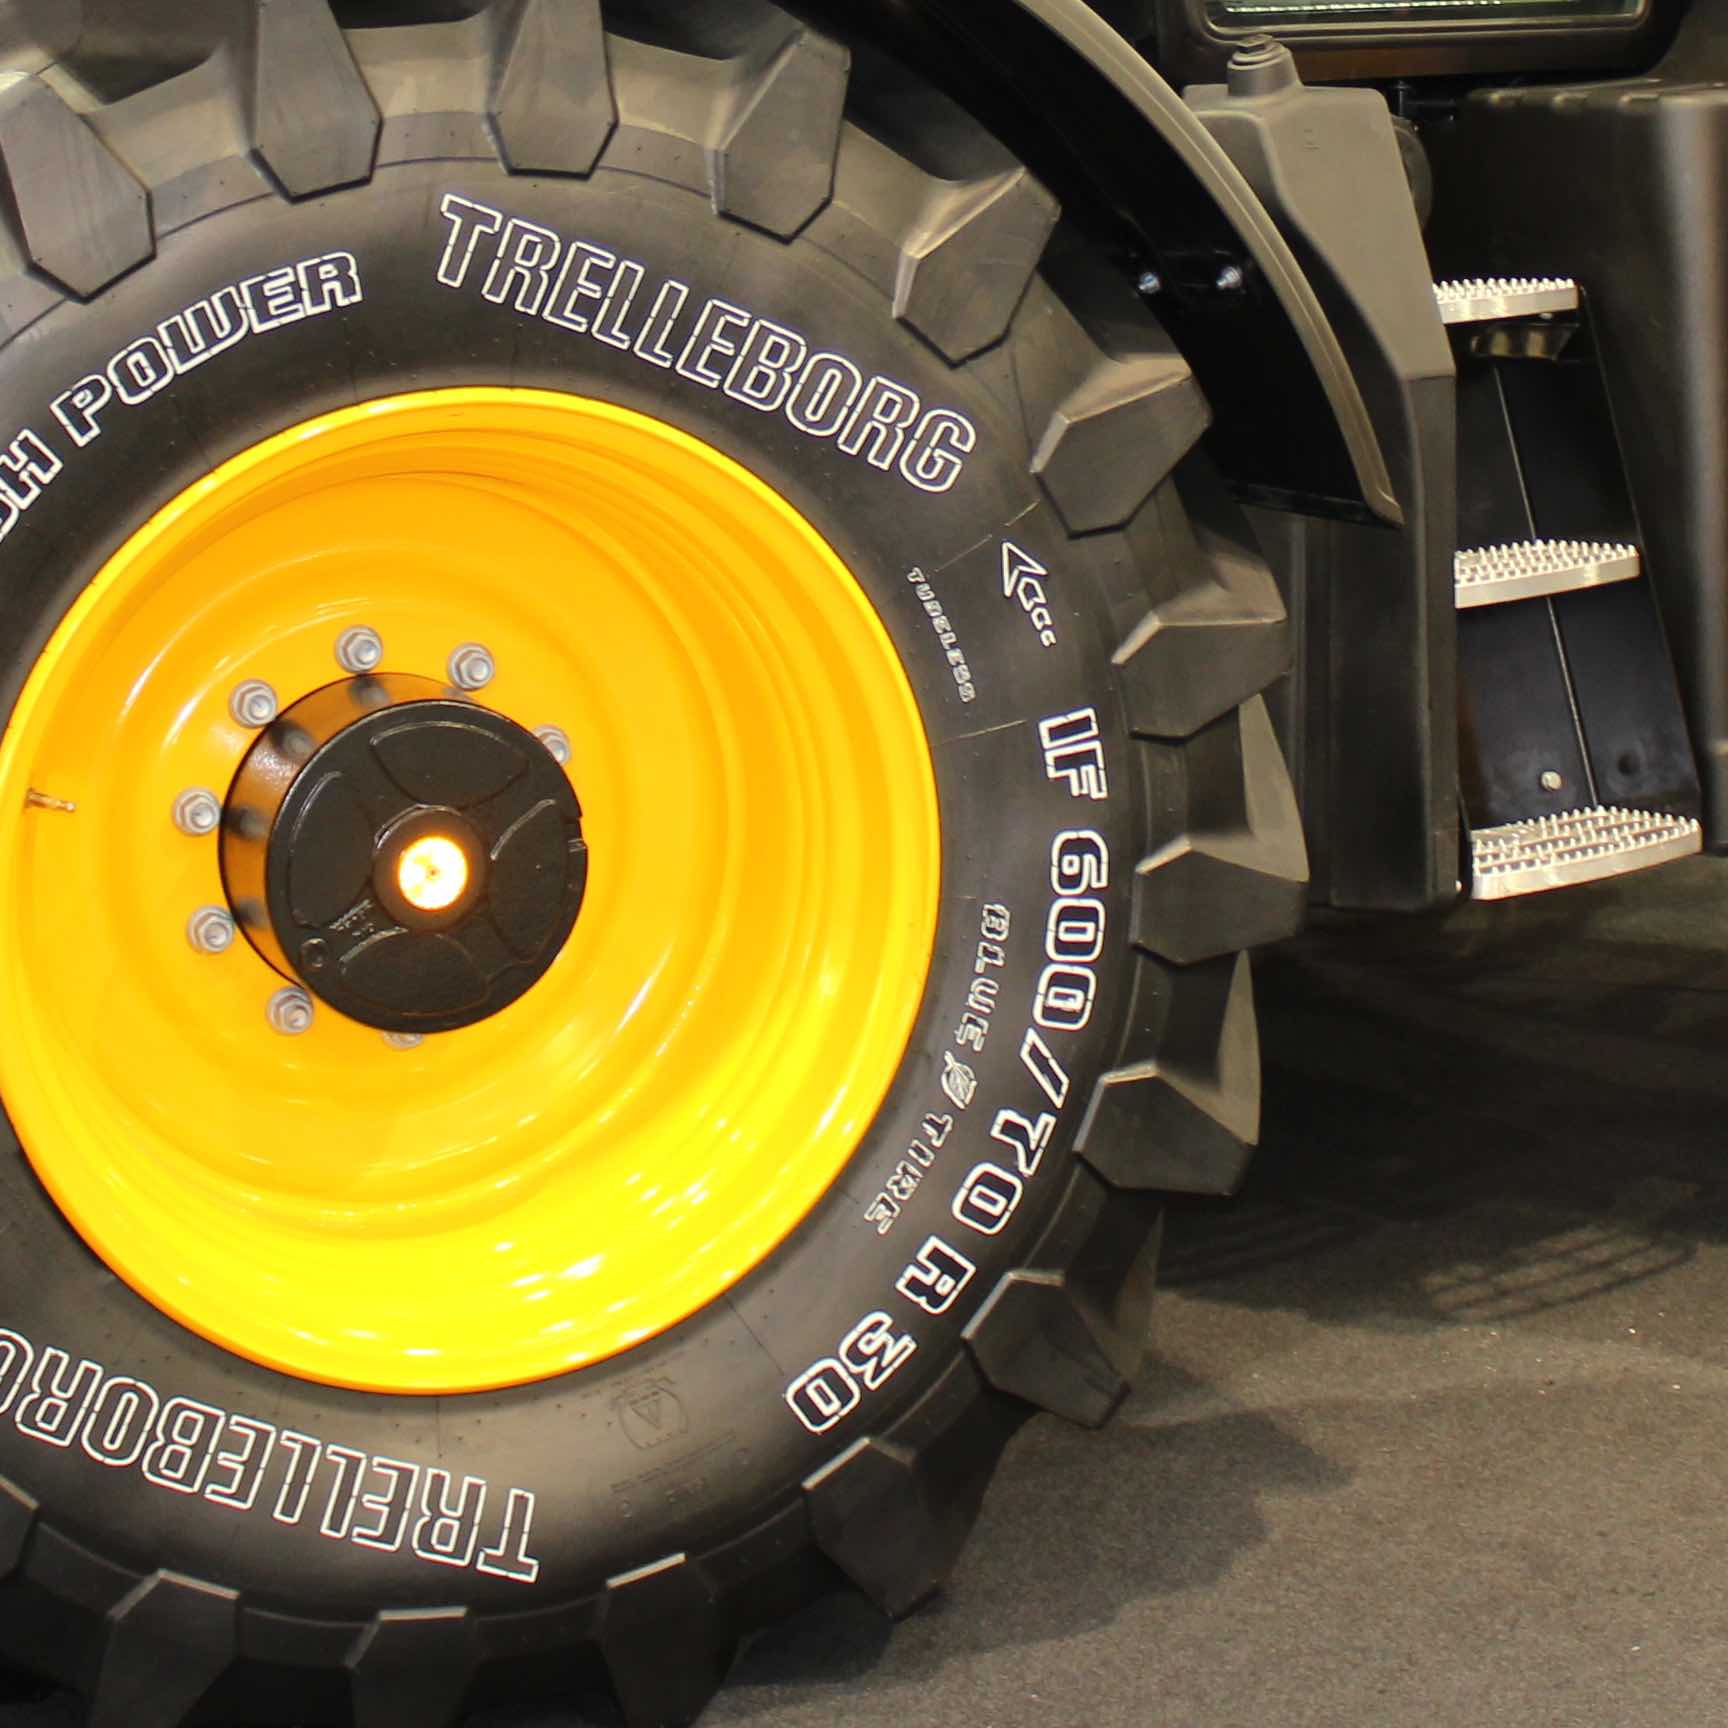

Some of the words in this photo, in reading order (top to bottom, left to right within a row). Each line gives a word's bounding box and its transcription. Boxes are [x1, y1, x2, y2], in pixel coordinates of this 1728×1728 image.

[49, 250, 365, 448] POWER
[437, 192, 978, 495] TRELLEBORG
[906, 566, 977, 704] TUBELESS
[1037, 707, 1110, 801] IF
[950, 828, 1110, 1239] 600/70
[955, 902, 1011, 1052] BLUE
[864, 1110, 955, 1236] TIRE
[895, 1234, 976, 1318] R
[785, 1310, 916, 1434] 30
